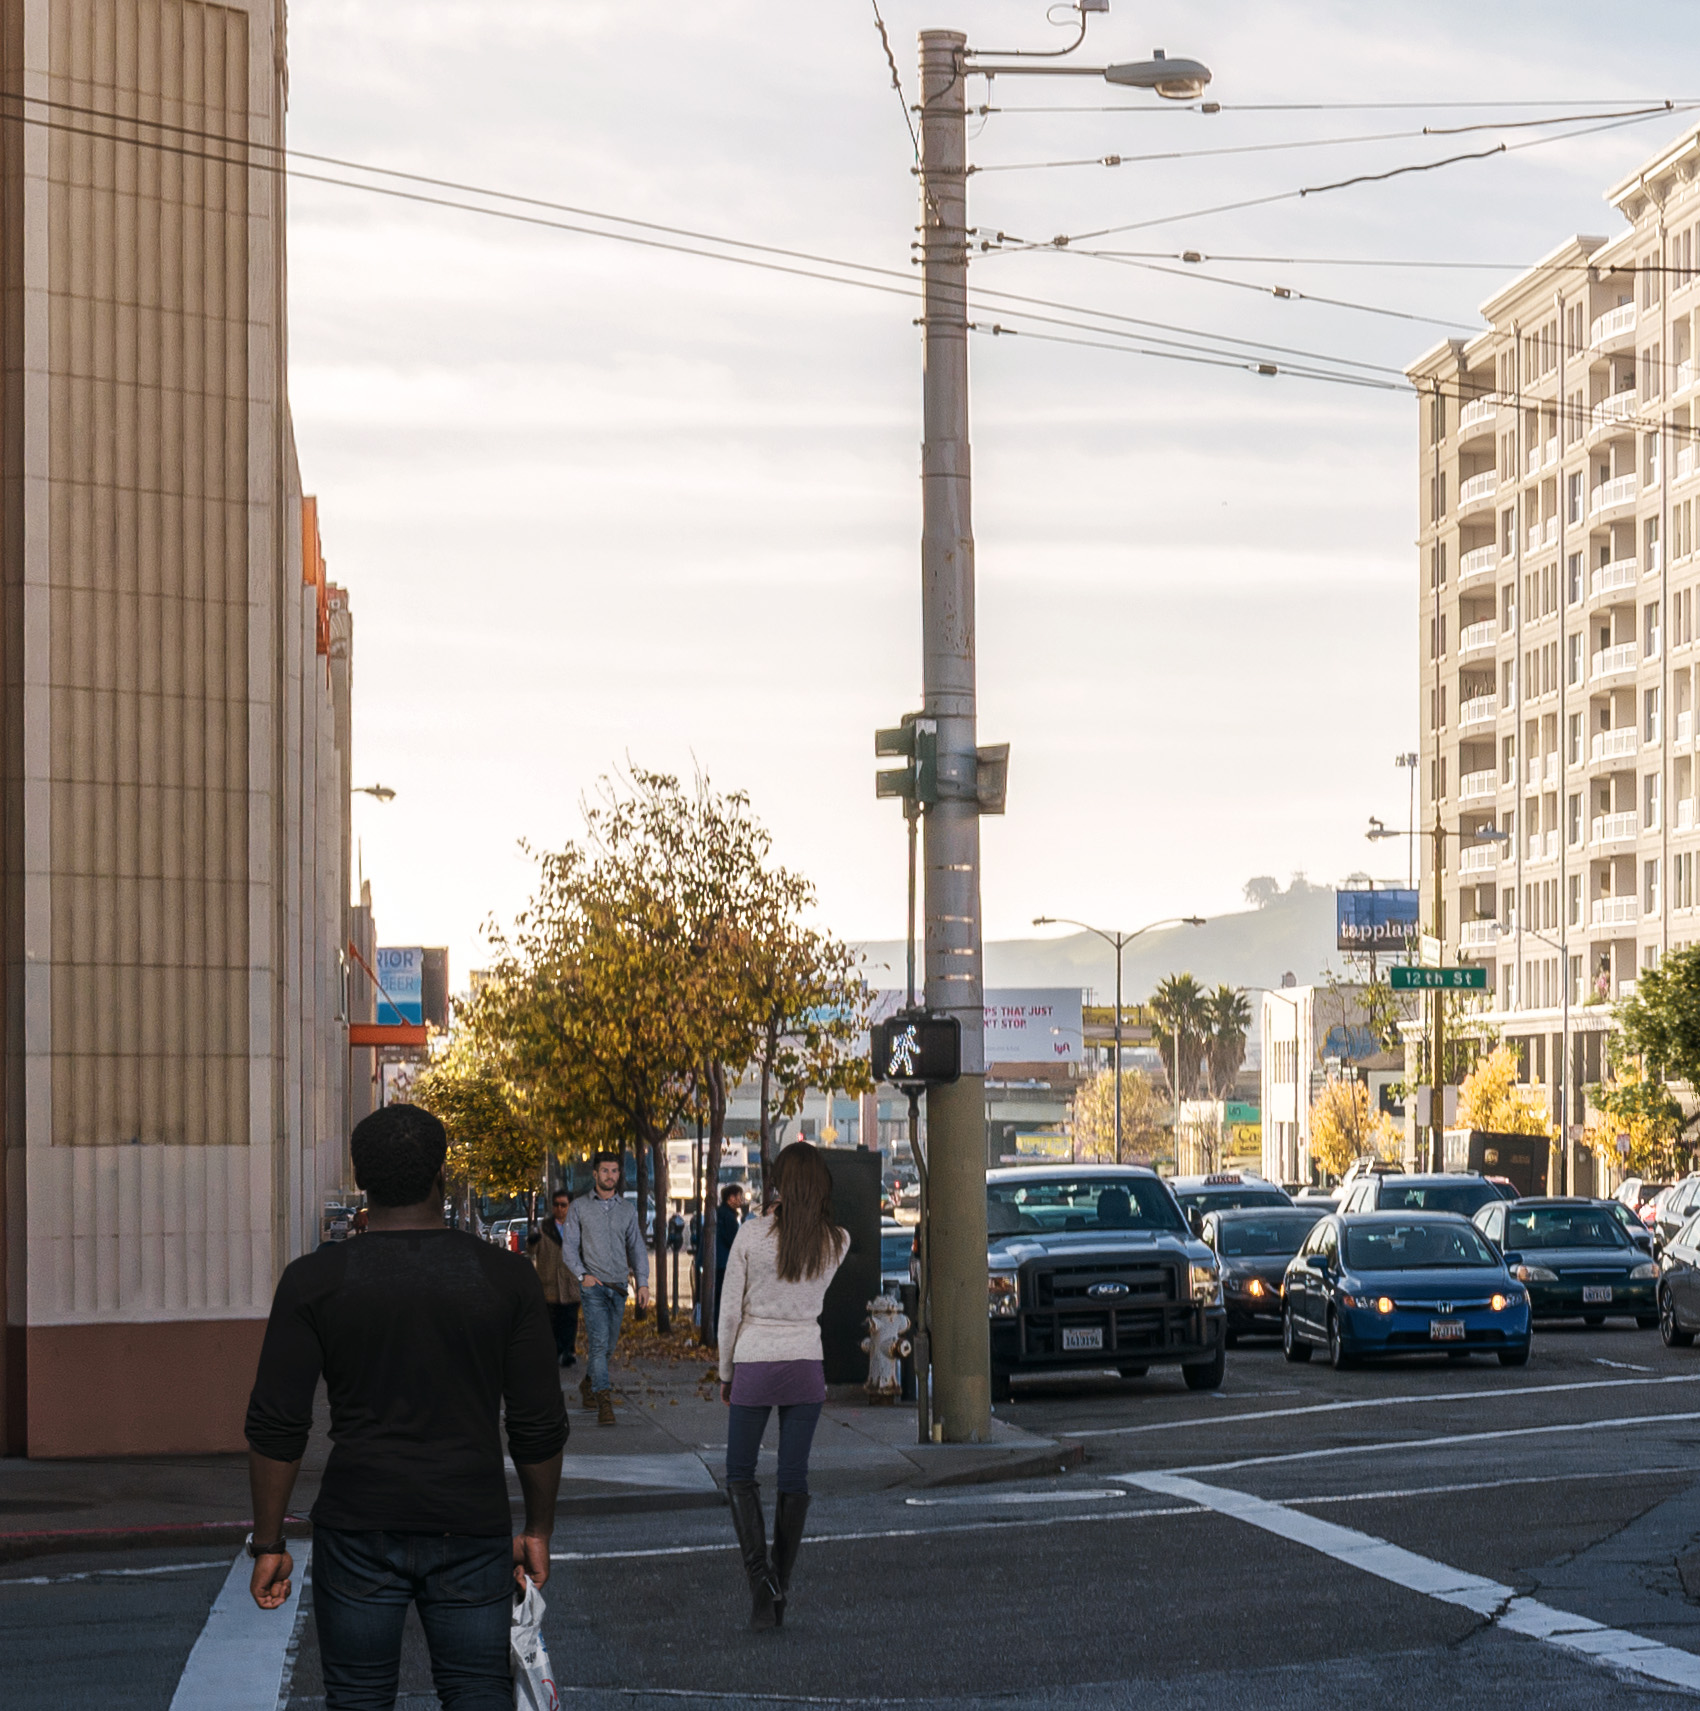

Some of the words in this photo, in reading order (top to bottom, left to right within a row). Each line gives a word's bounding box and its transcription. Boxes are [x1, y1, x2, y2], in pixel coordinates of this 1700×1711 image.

[1405, 971, 1443, 986] 12th
[1453, 971, 1472, 986] St
[1002, 1006, 1026, 1017] THAT
[1028, 1005, 1054, 1017] JUST
